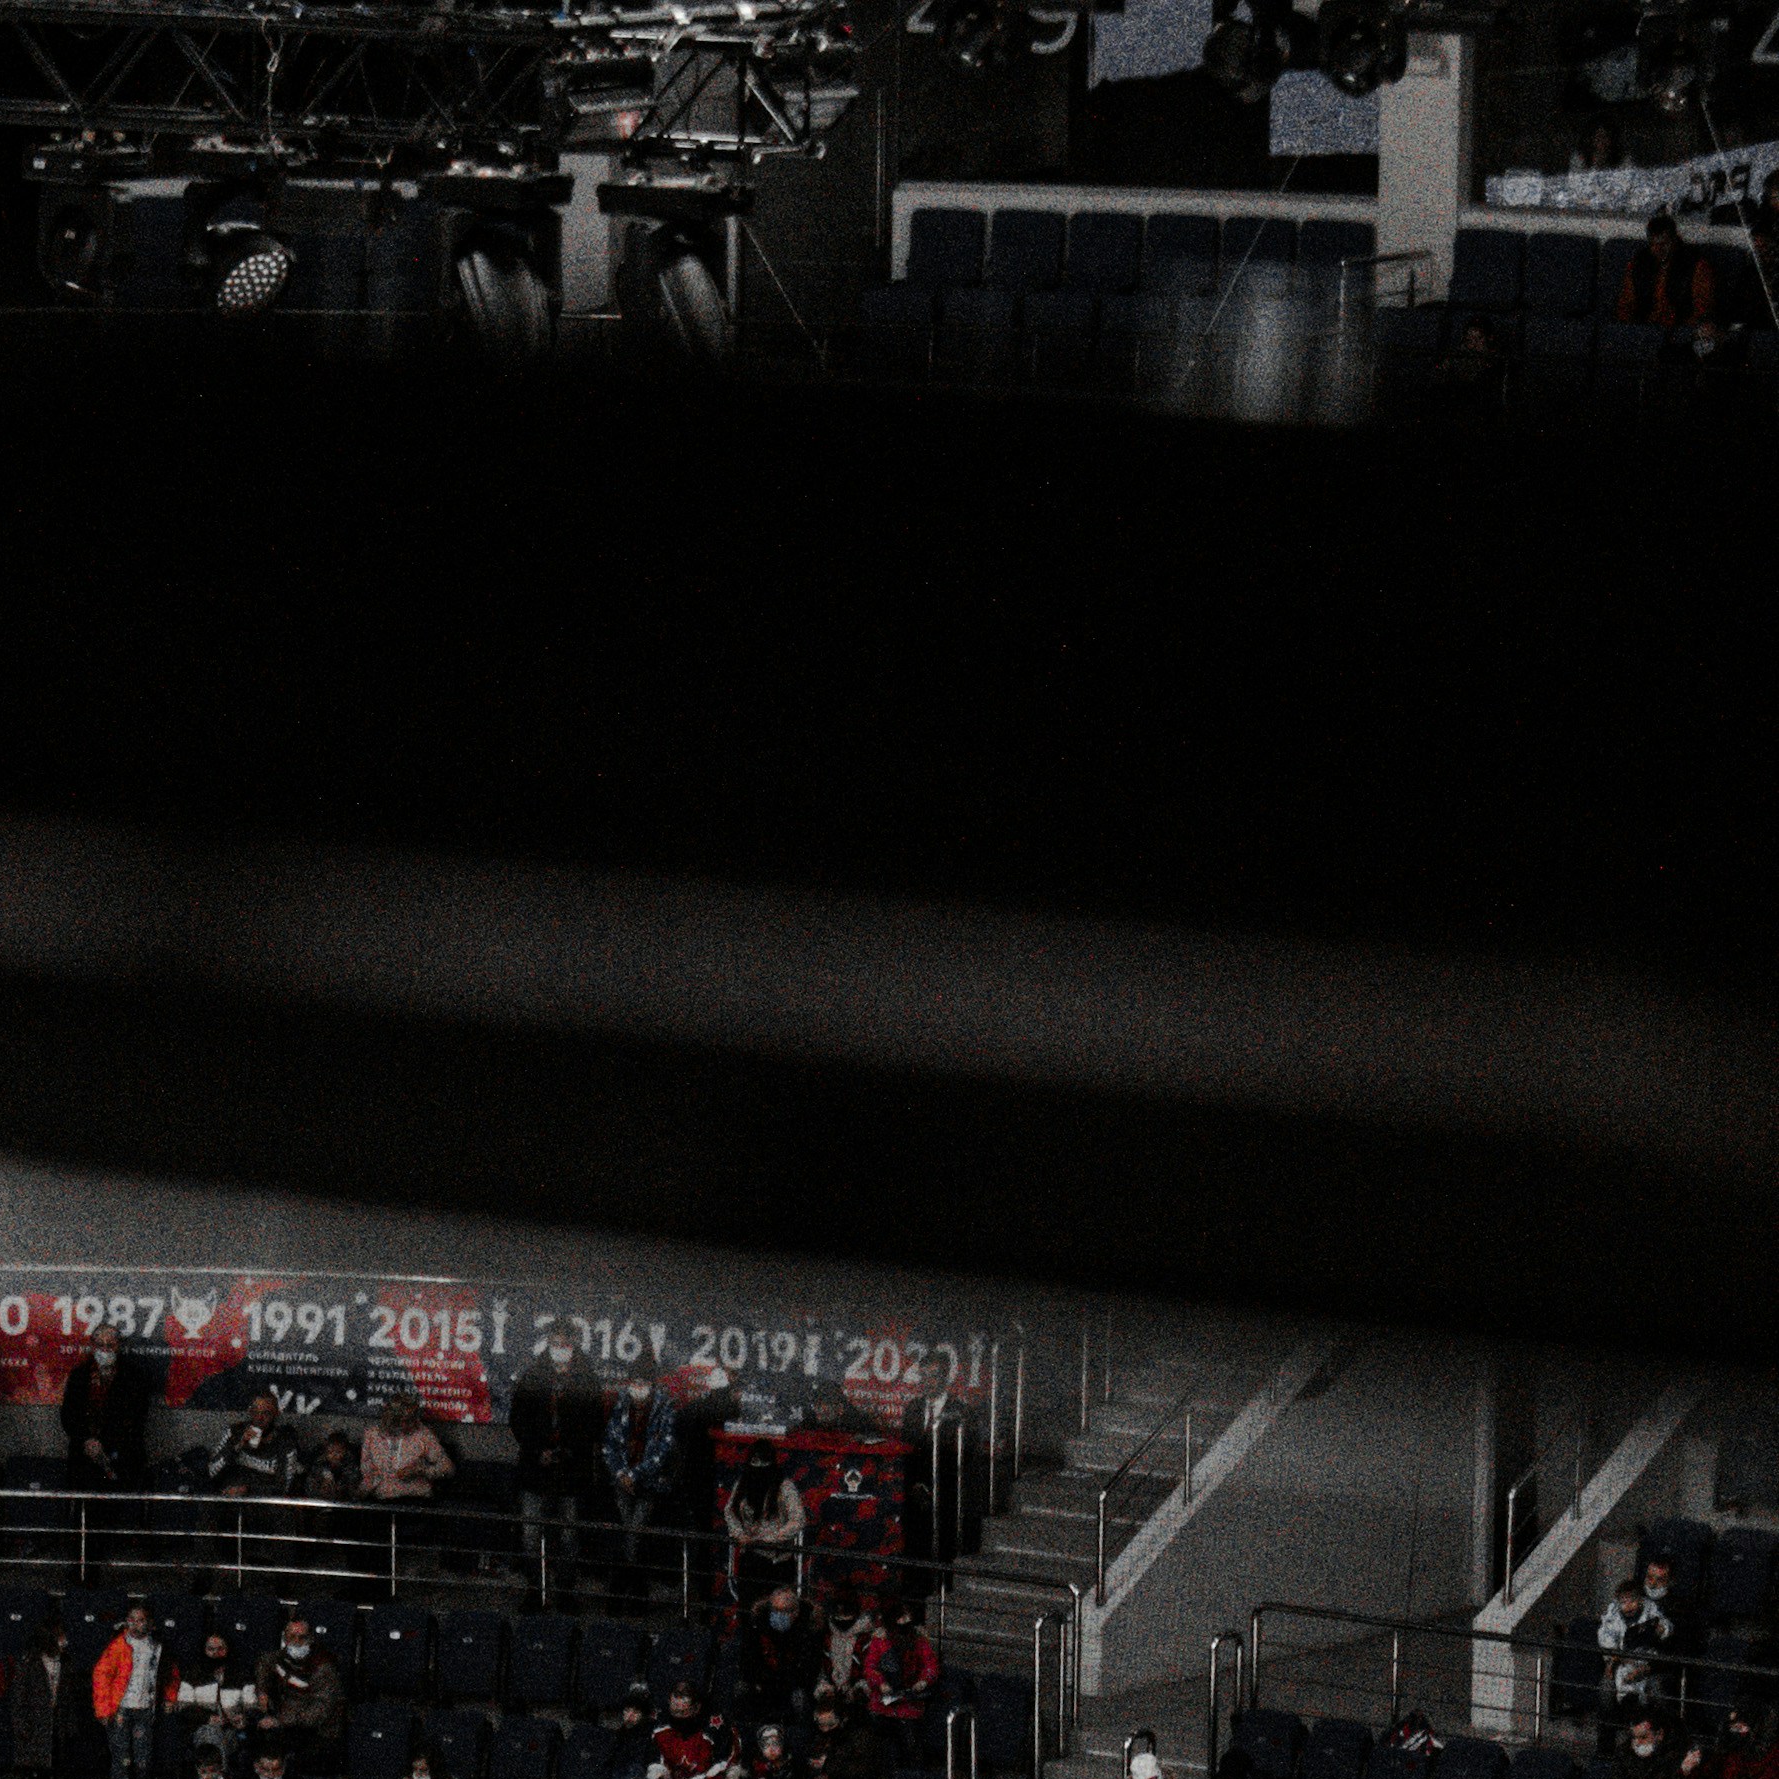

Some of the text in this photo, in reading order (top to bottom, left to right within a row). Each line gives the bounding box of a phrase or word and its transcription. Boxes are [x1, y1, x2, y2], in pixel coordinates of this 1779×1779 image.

[53, 1296, 166, 1338] 1987
[243, 1301, 346, 1346] 1991
[369, 1306, 483, 1352] 2015
[690, 1325, 796, 1372] 2019
